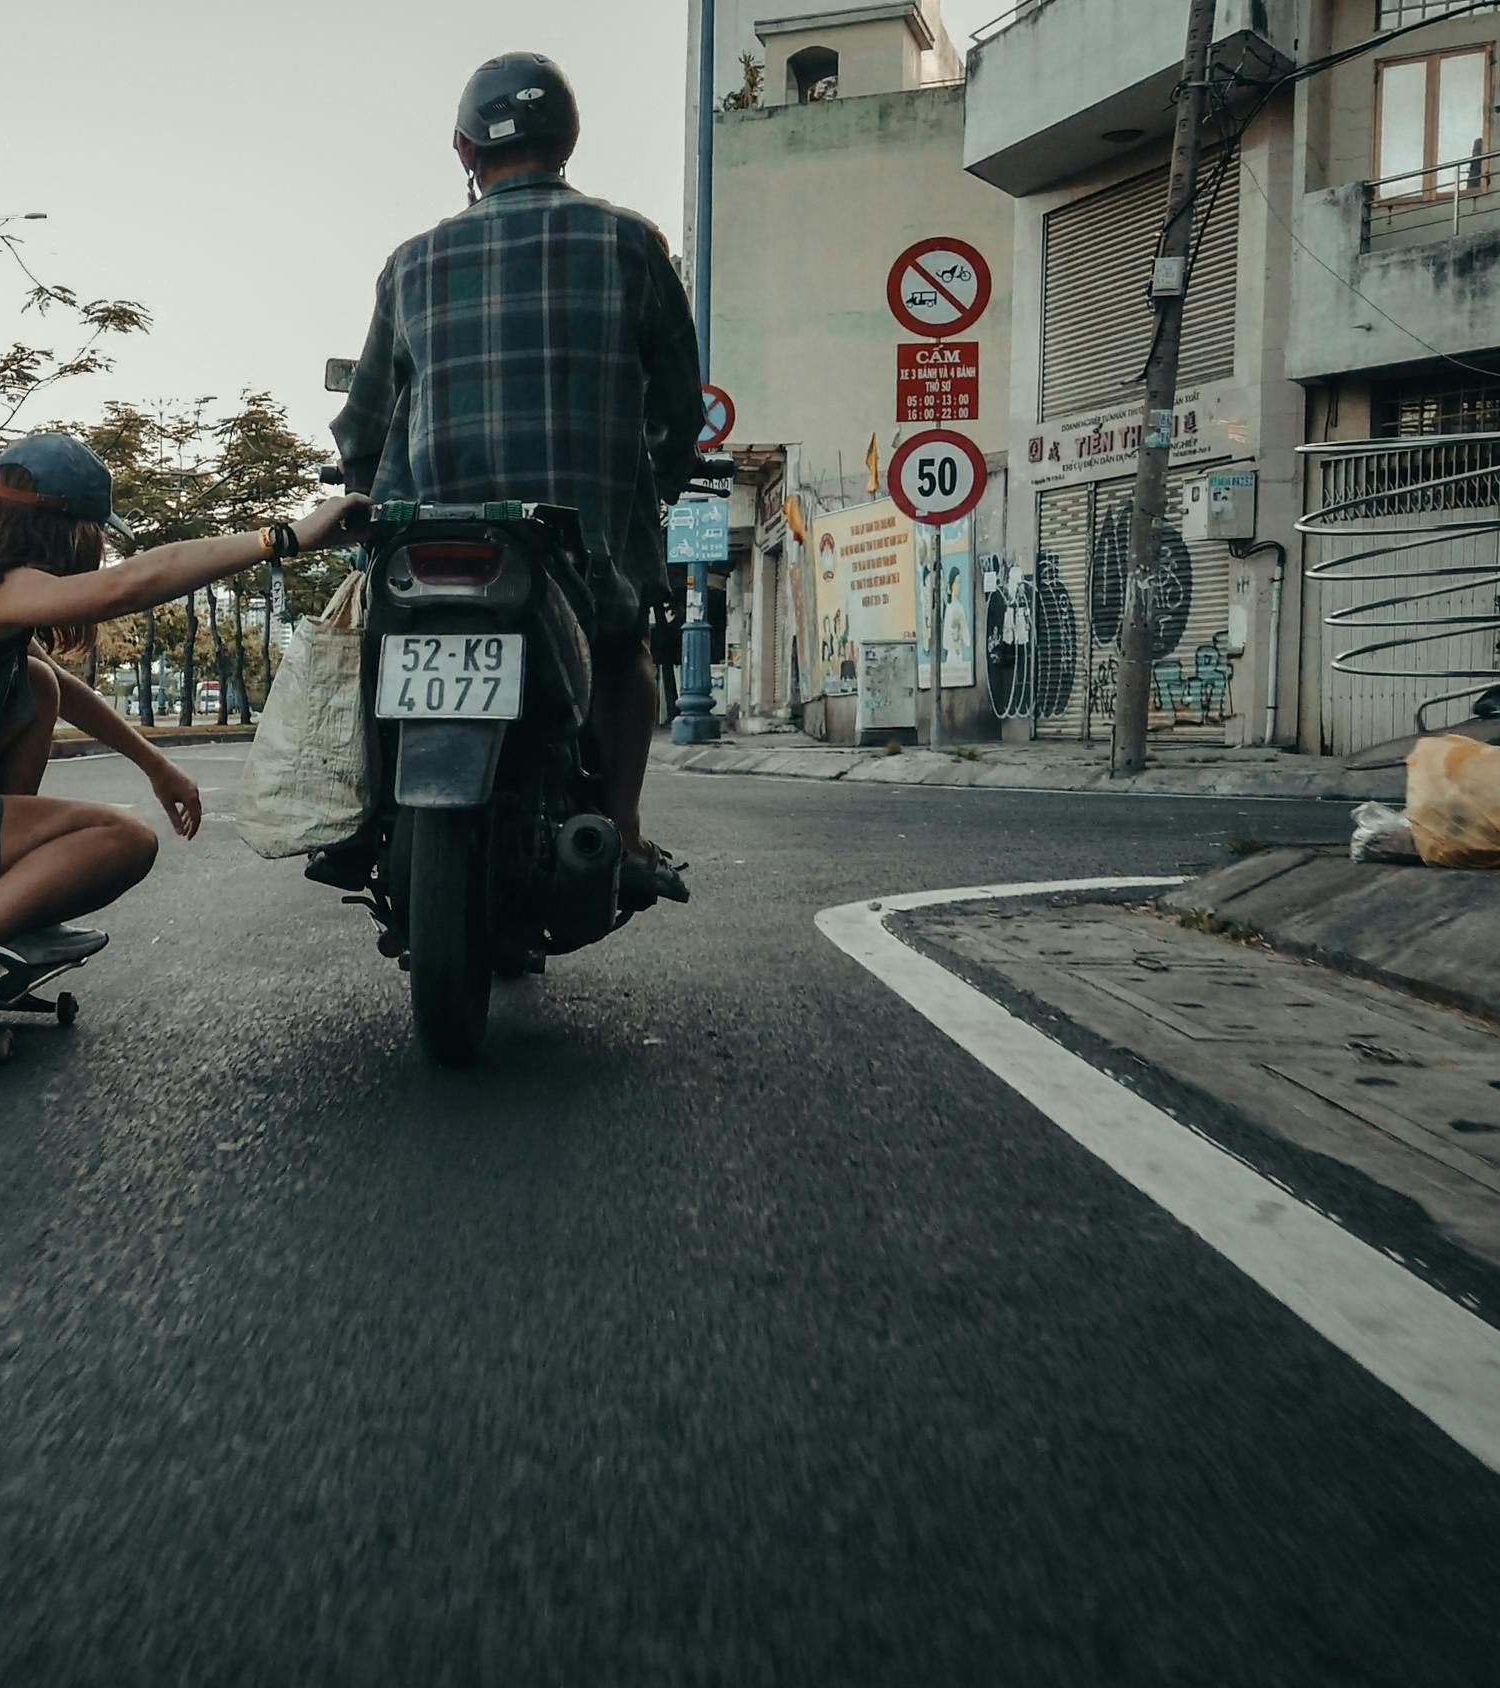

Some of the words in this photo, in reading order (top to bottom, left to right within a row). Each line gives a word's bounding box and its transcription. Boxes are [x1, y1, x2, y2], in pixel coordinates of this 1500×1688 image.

[915, 344, 961, 364] CẤM
[900, 368, 910, 380] XE
[911, 368, 916, 380] 3
[949, 367, 955, 378] 4
[918, 457, 957, 497] 50
[401, 638, 504, 672] 52-K9
[398, 677, 501, 711] 4077
